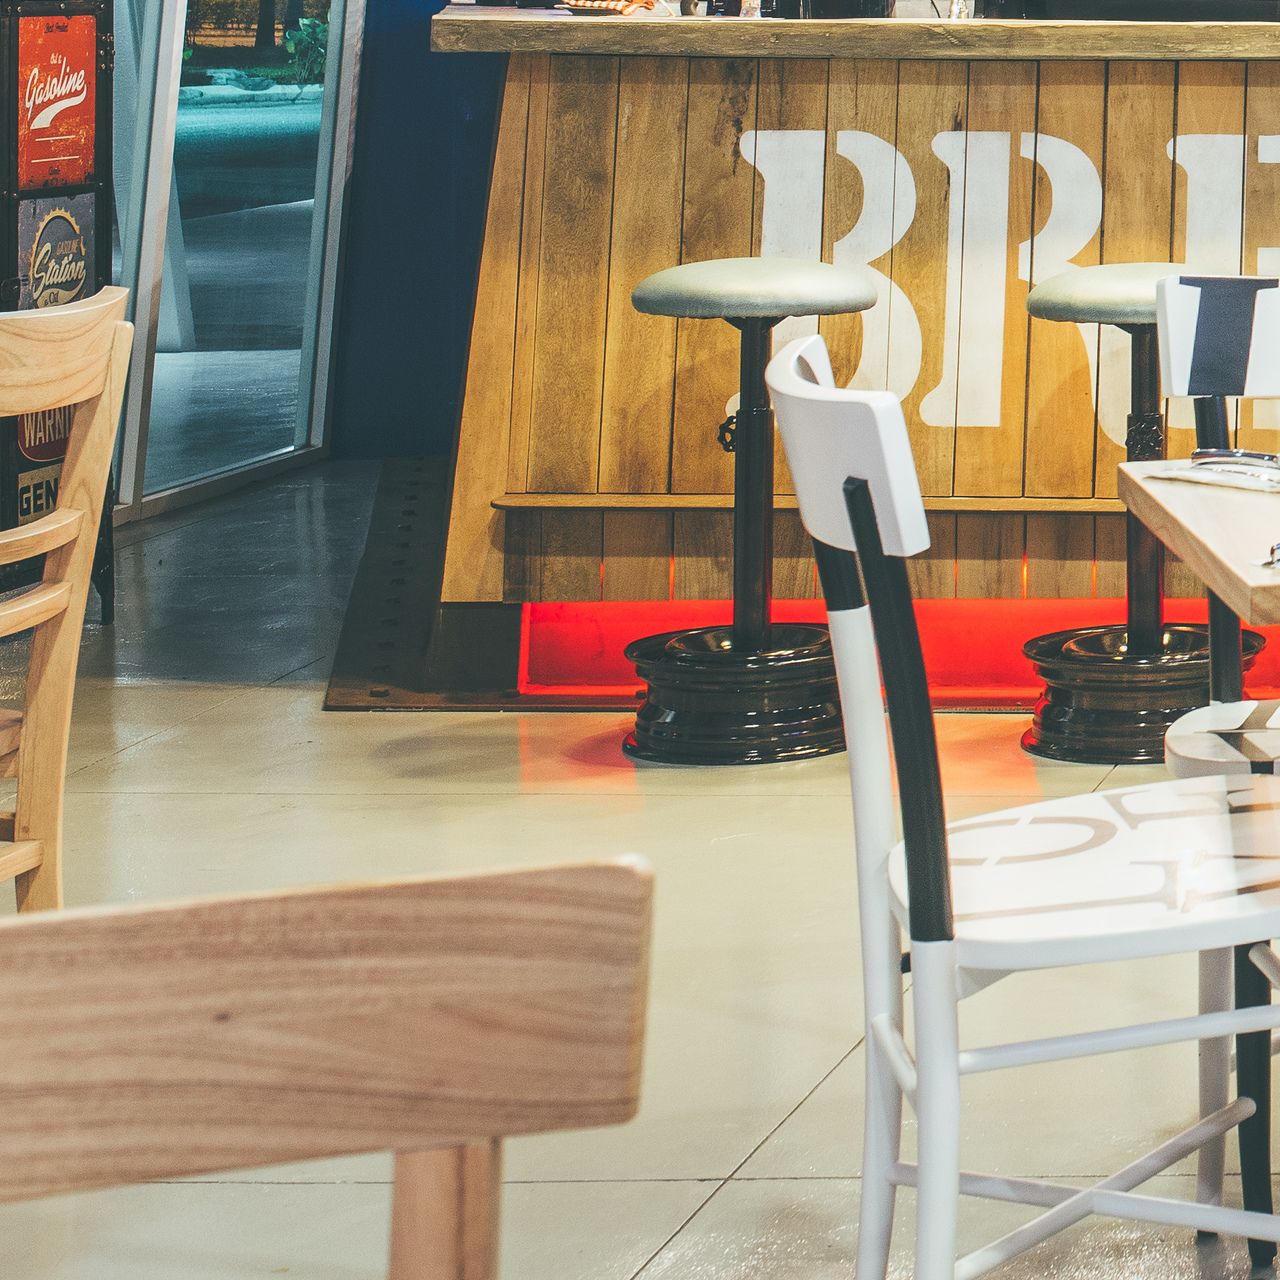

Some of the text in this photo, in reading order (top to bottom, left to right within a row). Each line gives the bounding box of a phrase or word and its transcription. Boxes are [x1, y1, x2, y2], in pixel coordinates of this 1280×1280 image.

[25, 56, 86, 121] Gasoline
[32, 242, 87, 300] Station
[23, 405, 75, 449] WARNI
